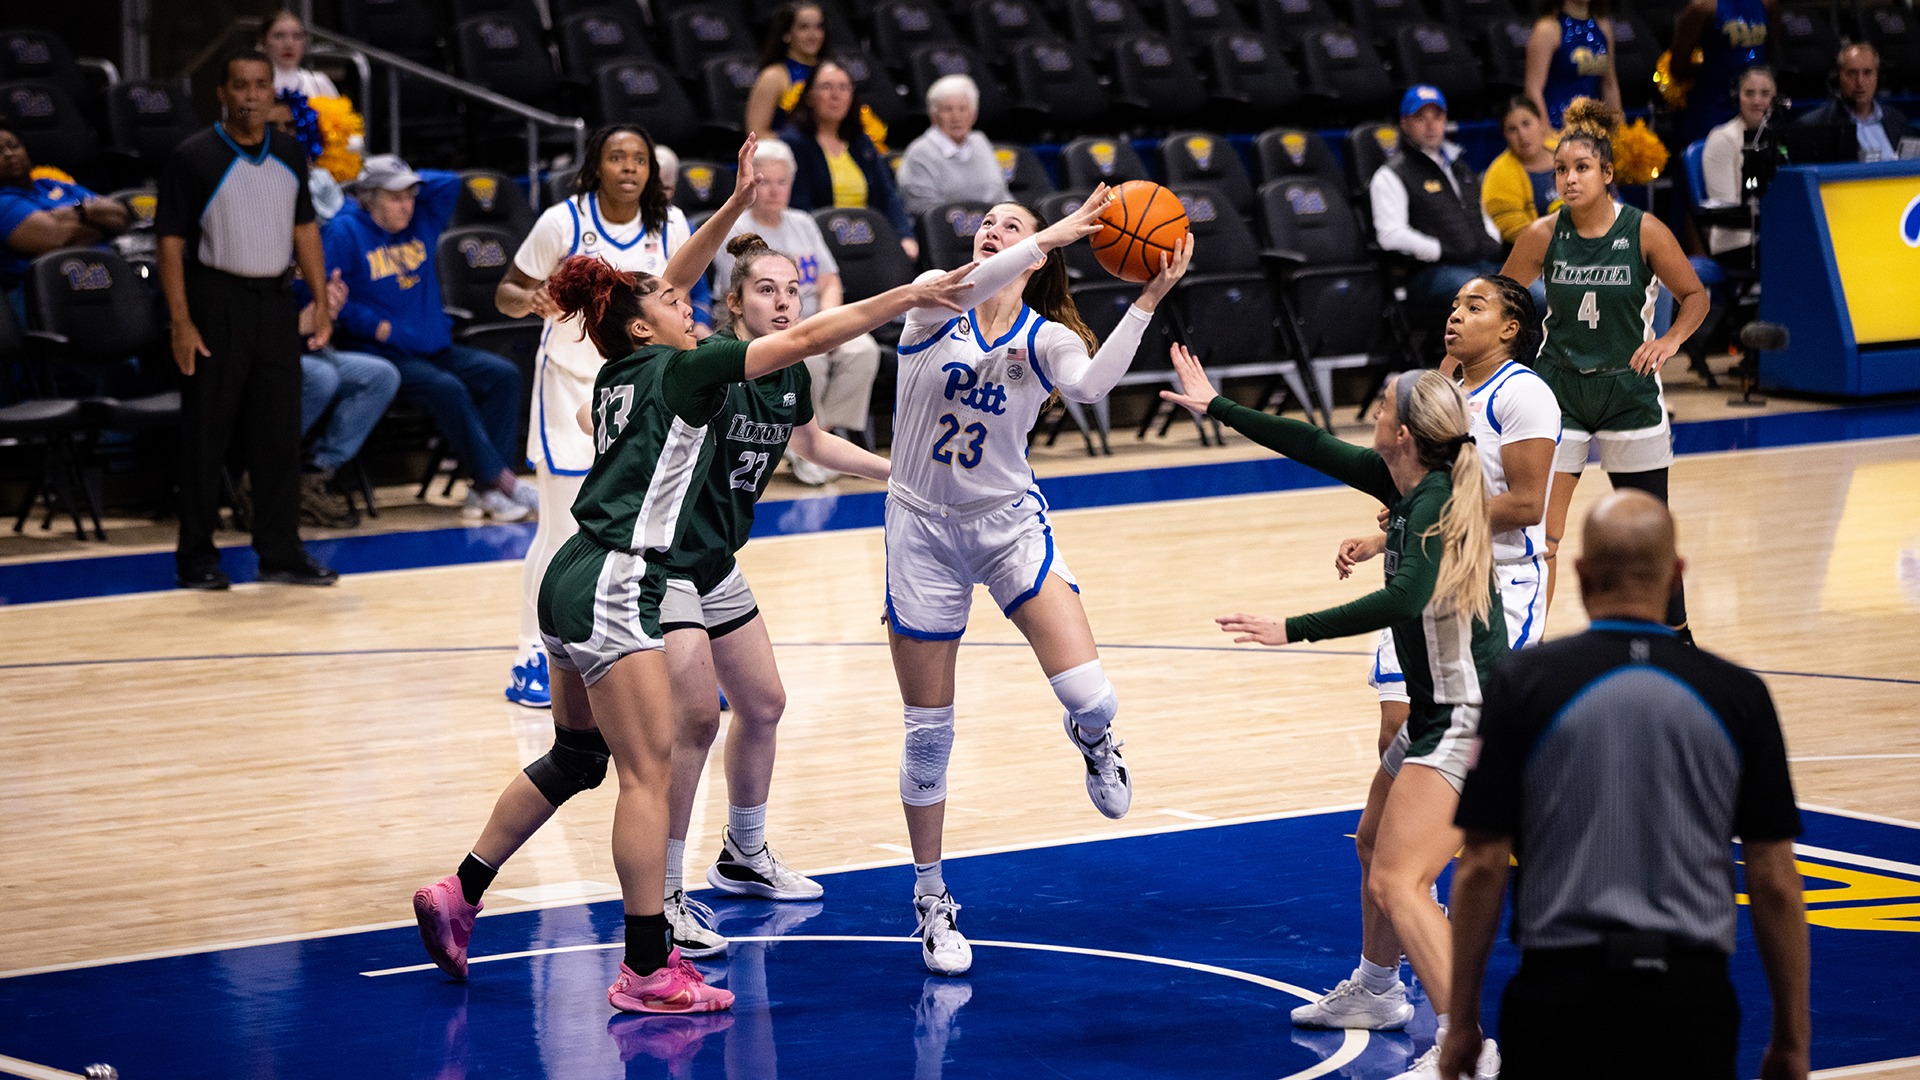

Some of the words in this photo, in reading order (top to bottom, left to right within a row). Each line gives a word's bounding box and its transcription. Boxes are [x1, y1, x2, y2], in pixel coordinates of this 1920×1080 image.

[1551, 260, 1631, 285] LOYOLA
[1577, 292, 1600, 329] 4
[942, 362, 1007, 415] Pitt
[597, 384, 634, 454] 13
[932, 413, 988, 470] 23
[730, 451, 770, 492] 23
